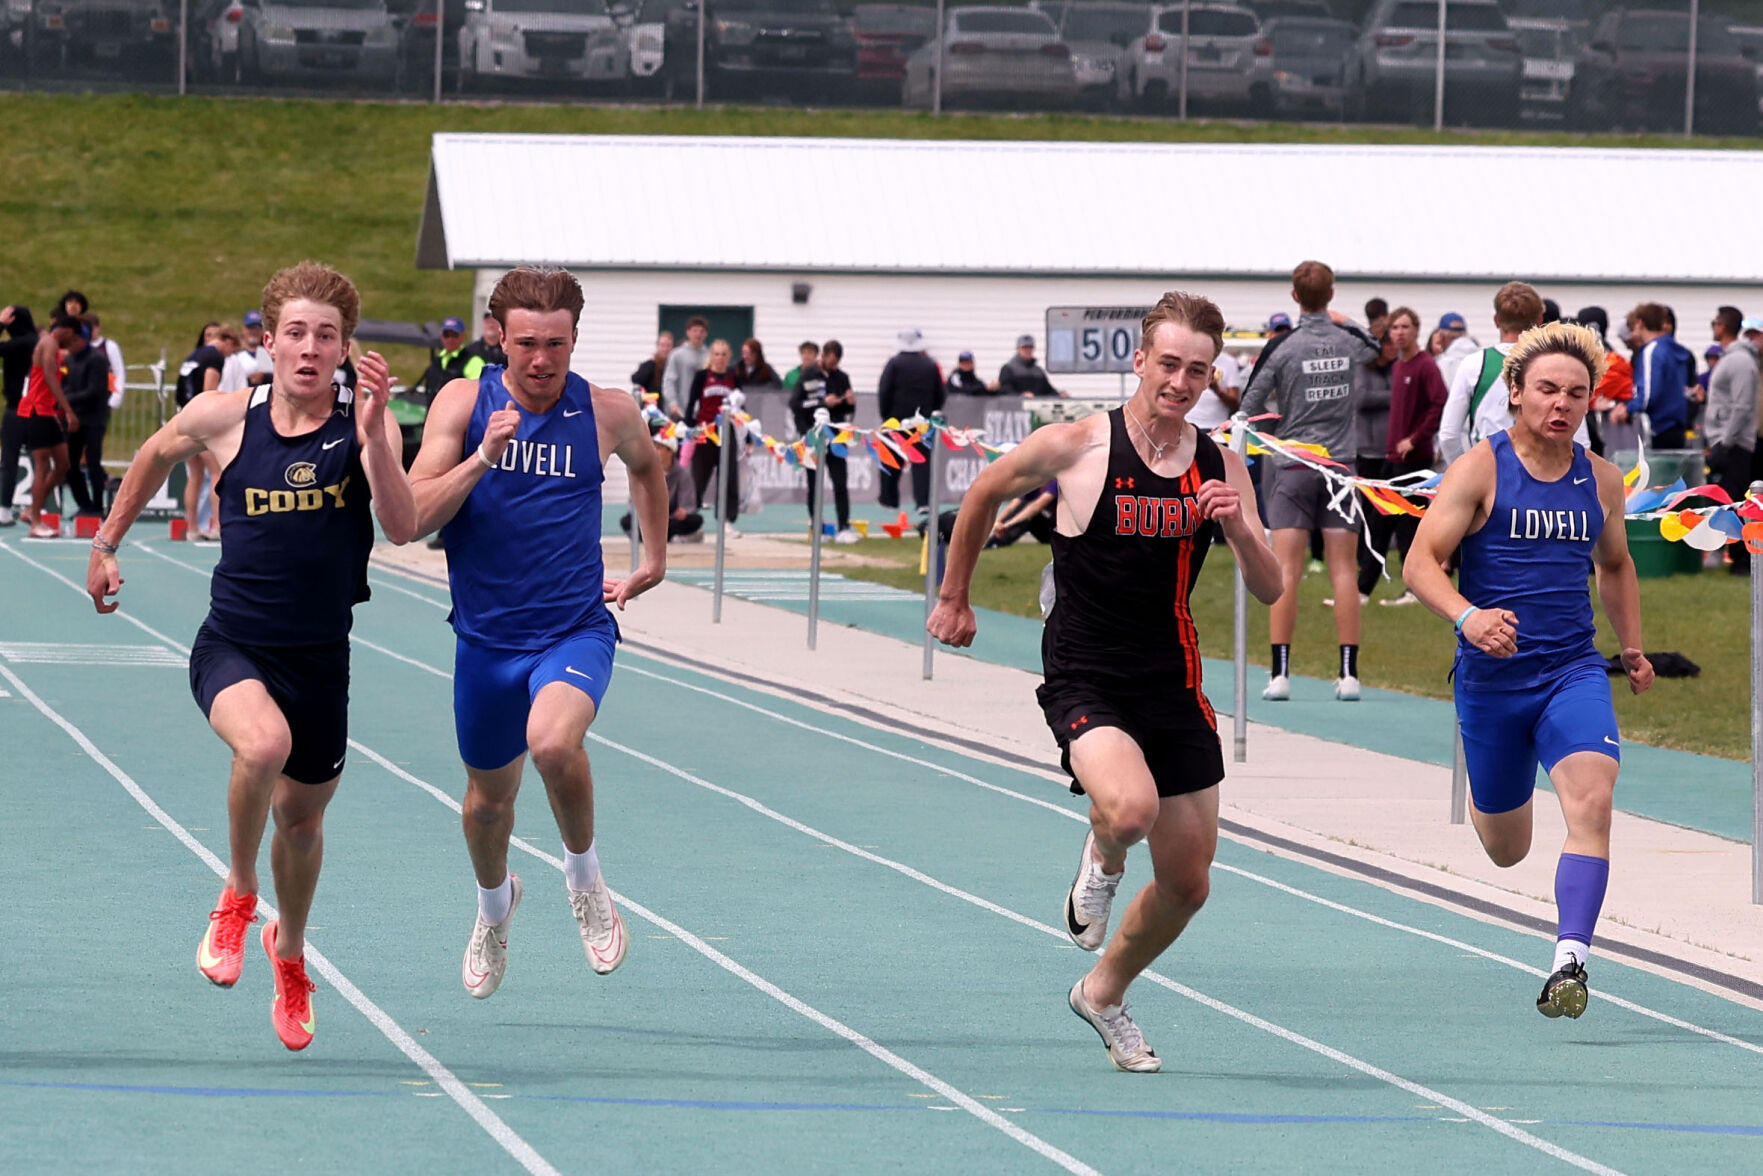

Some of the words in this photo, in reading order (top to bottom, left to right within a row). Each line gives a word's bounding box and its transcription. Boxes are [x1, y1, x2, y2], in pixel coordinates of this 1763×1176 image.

[1082, 328, 1131, 361] 50
[1310, 360, 1344, 371] SLEEP
[1308, 386, 1349, 399] REPEAT
[491, 438, 577, 478] OVELL
[244, 475, 351, 516] CODY
[1509, 507, 1591, 542] LOVELL
